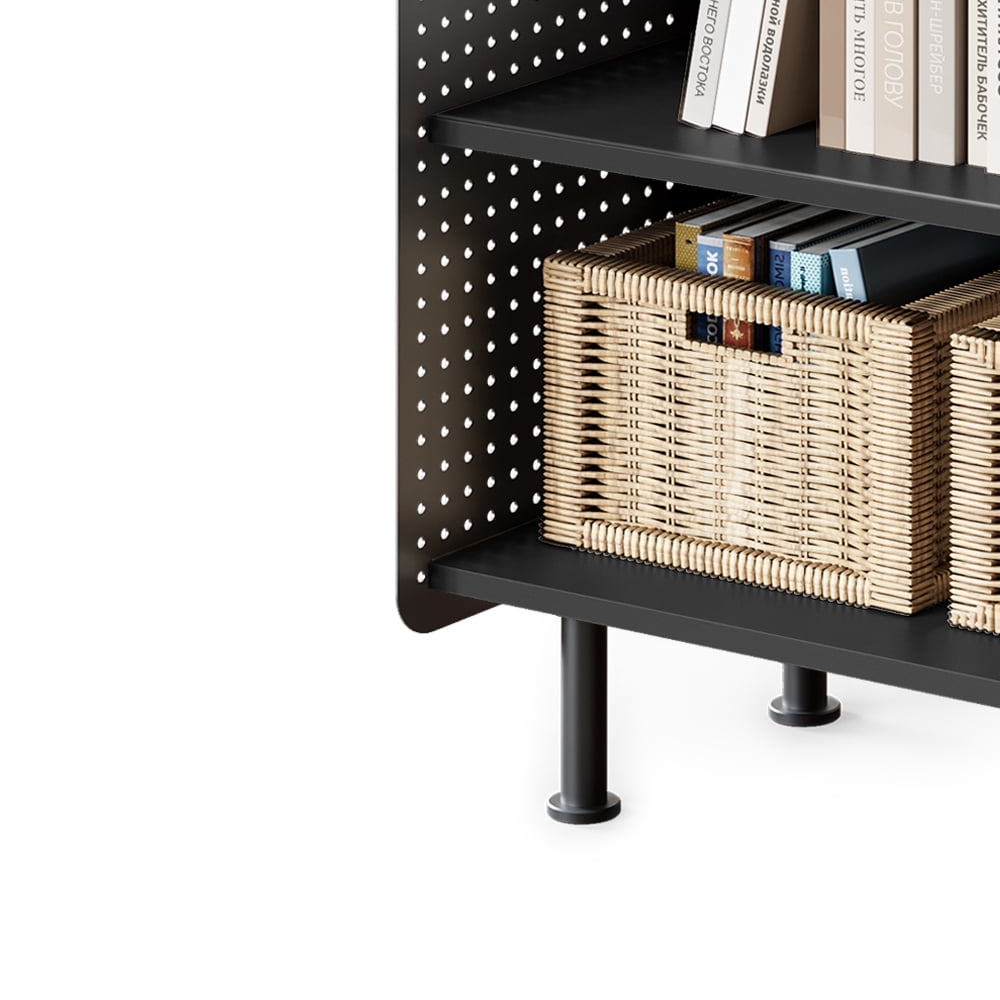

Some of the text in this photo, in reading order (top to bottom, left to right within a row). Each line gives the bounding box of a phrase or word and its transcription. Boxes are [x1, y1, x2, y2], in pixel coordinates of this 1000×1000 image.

[884, 1, 904, 15] В
[694, 37, 712, 97] ВОСТОКА
[756, 28, 777, 105] водолазки
[854, 30, 866, 102] МНОГОЕ
[884, 21, 904, 109] ГОЛОВУ
[976, 75, 988, 141] БАБОЧЕК
